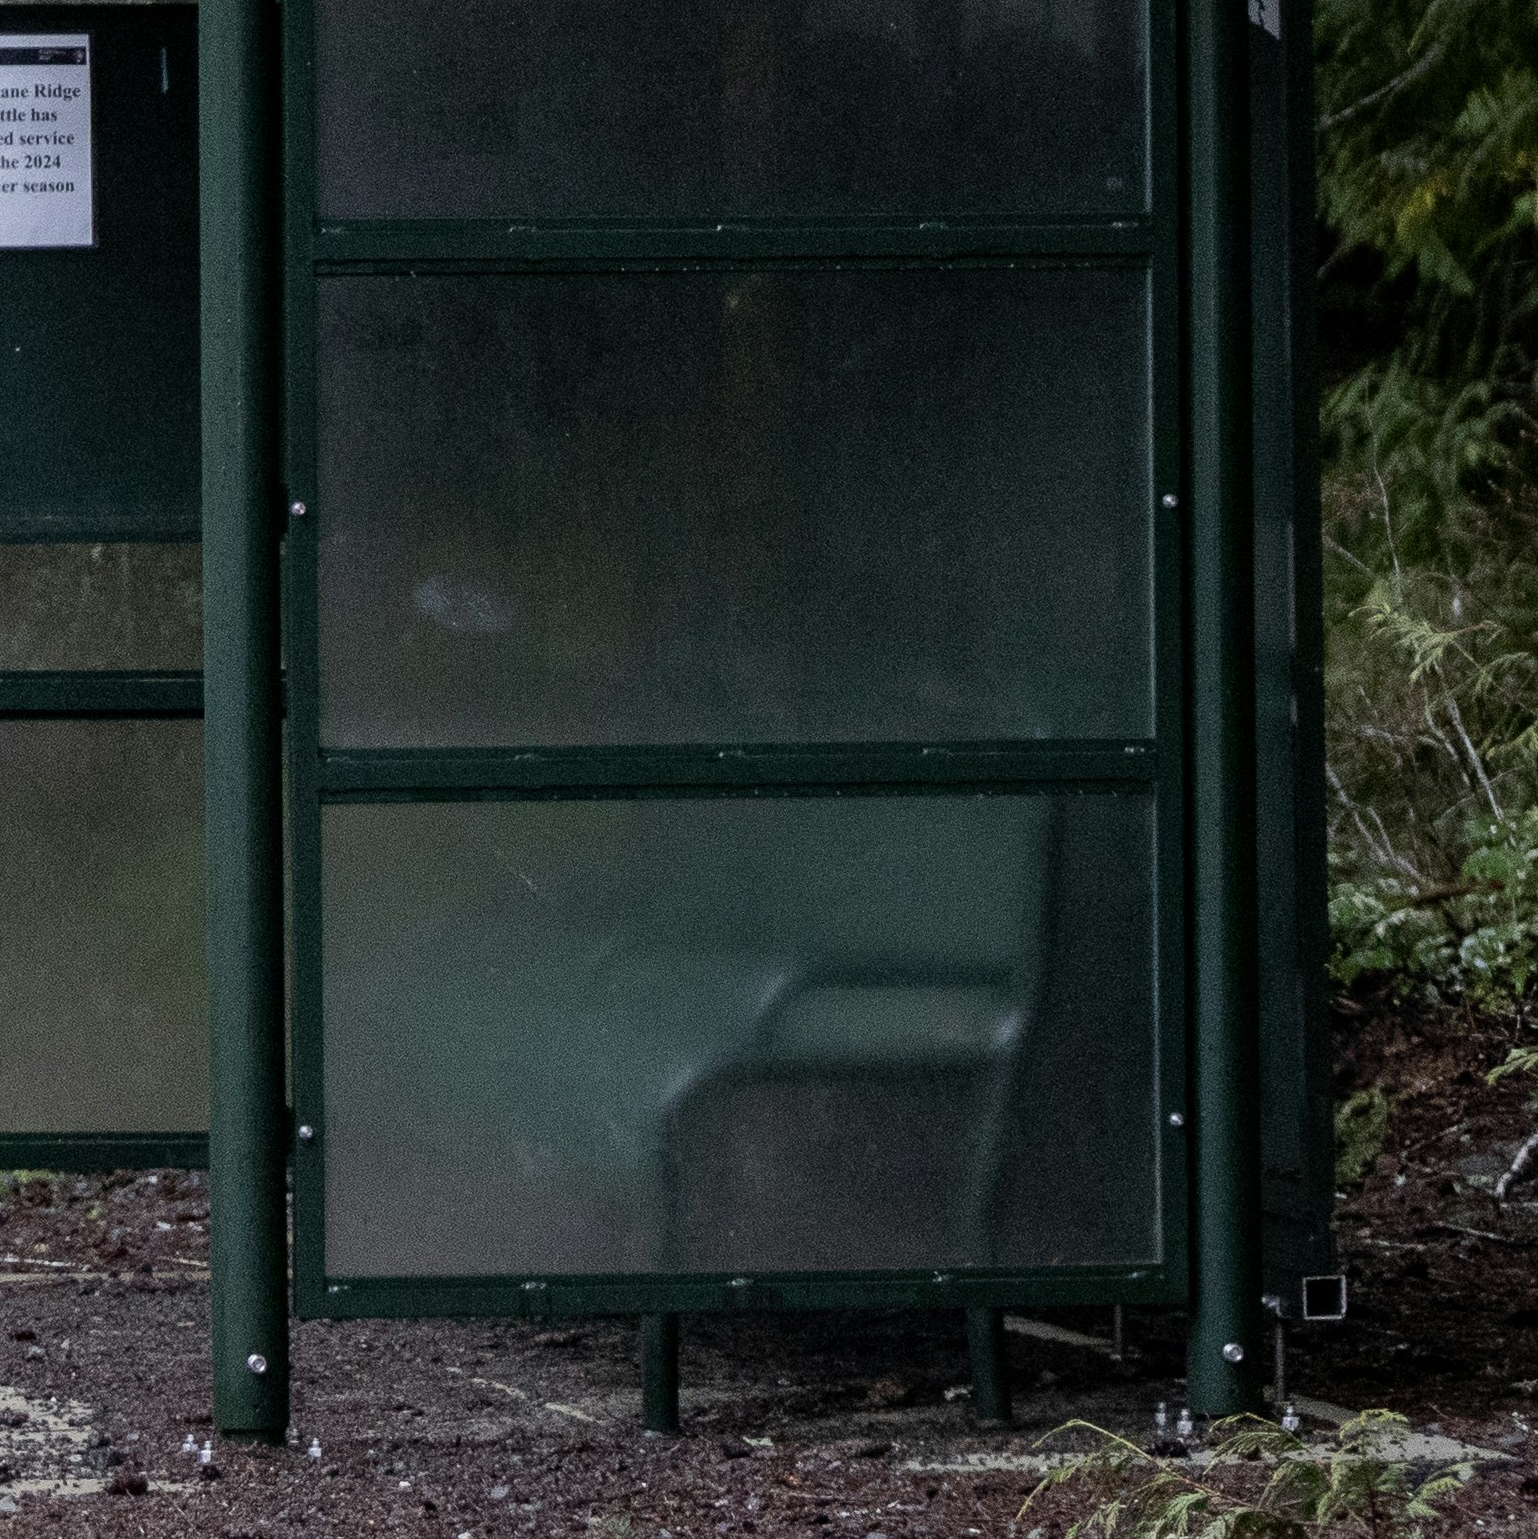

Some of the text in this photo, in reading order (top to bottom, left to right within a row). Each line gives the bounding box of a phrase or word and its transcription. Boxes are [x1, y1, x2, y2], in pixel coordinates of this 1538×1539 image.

[34, 83, 81, 101] Ridge
[31, 108, 58, 122] has
[19, 131, 75, 145] service
[24, 154, 61, 169] 2024
[24, 180, 75, 193] season
